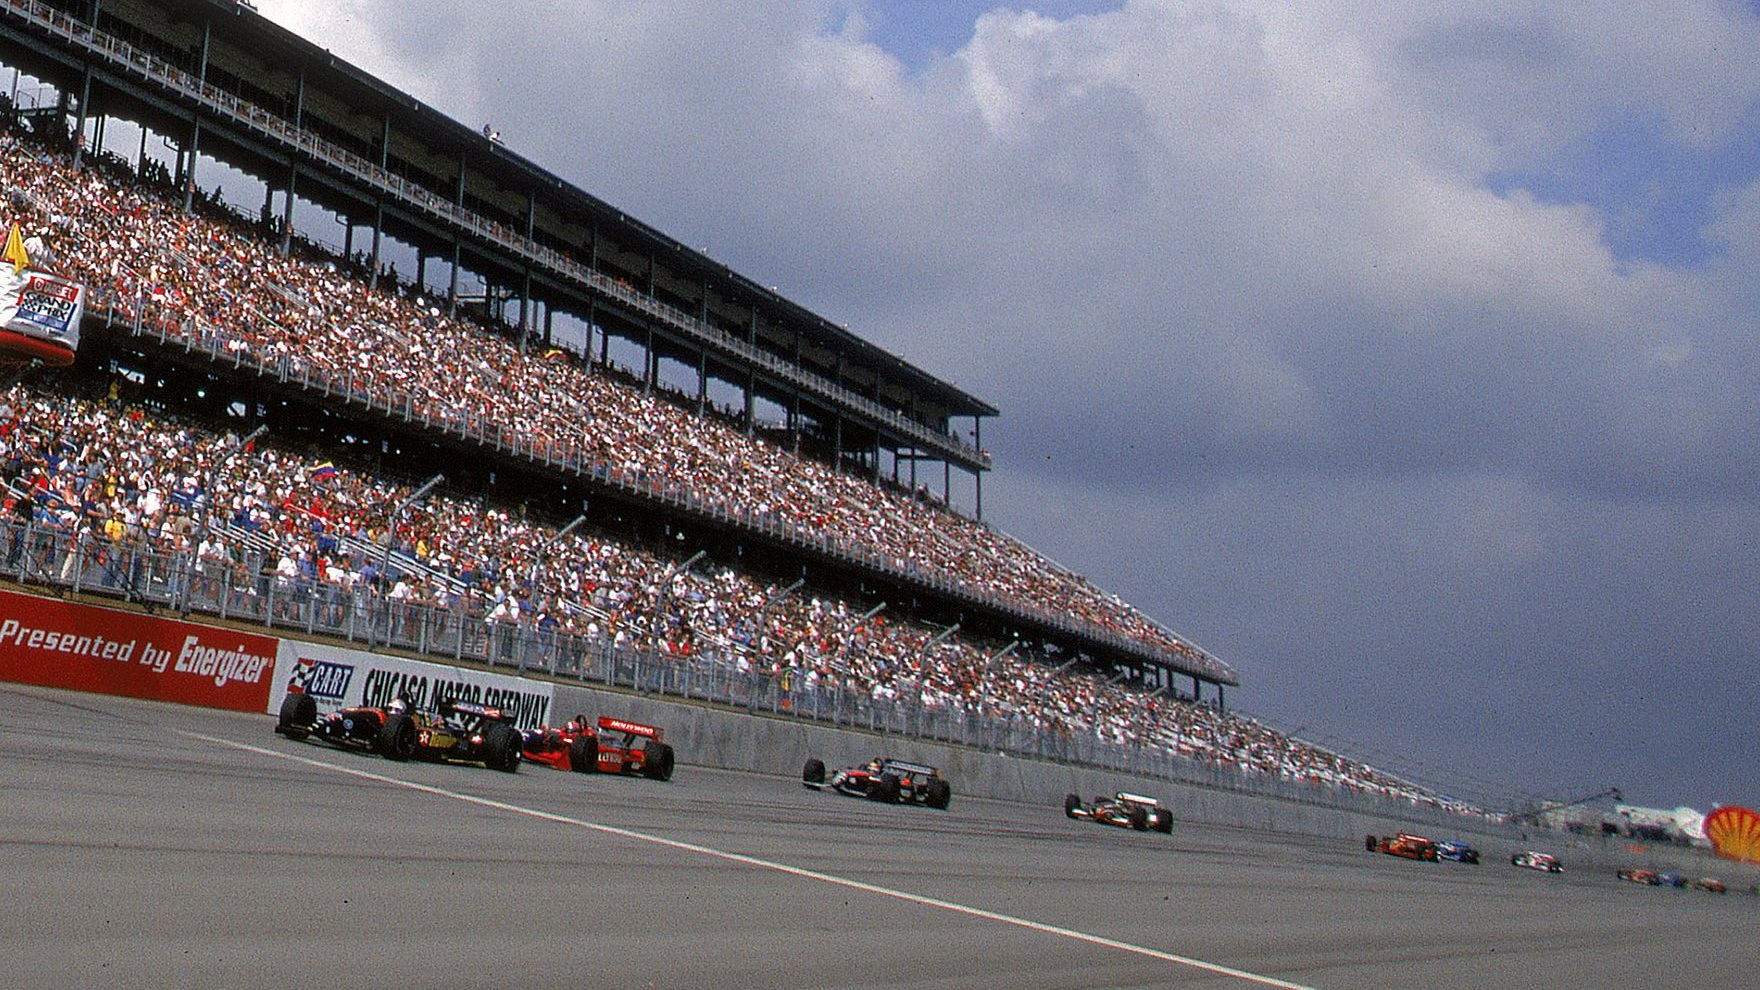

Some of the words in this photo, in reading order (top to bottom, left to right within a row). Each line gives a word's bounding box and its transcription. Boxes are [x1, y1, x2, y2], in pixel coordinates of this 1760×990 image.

[25, 291, 71, 311] GRAND
[140, 642, 171, 673] by
[174, 635, 270, 687] Energizer
[362, 668, 427, 711] CHICAGO
